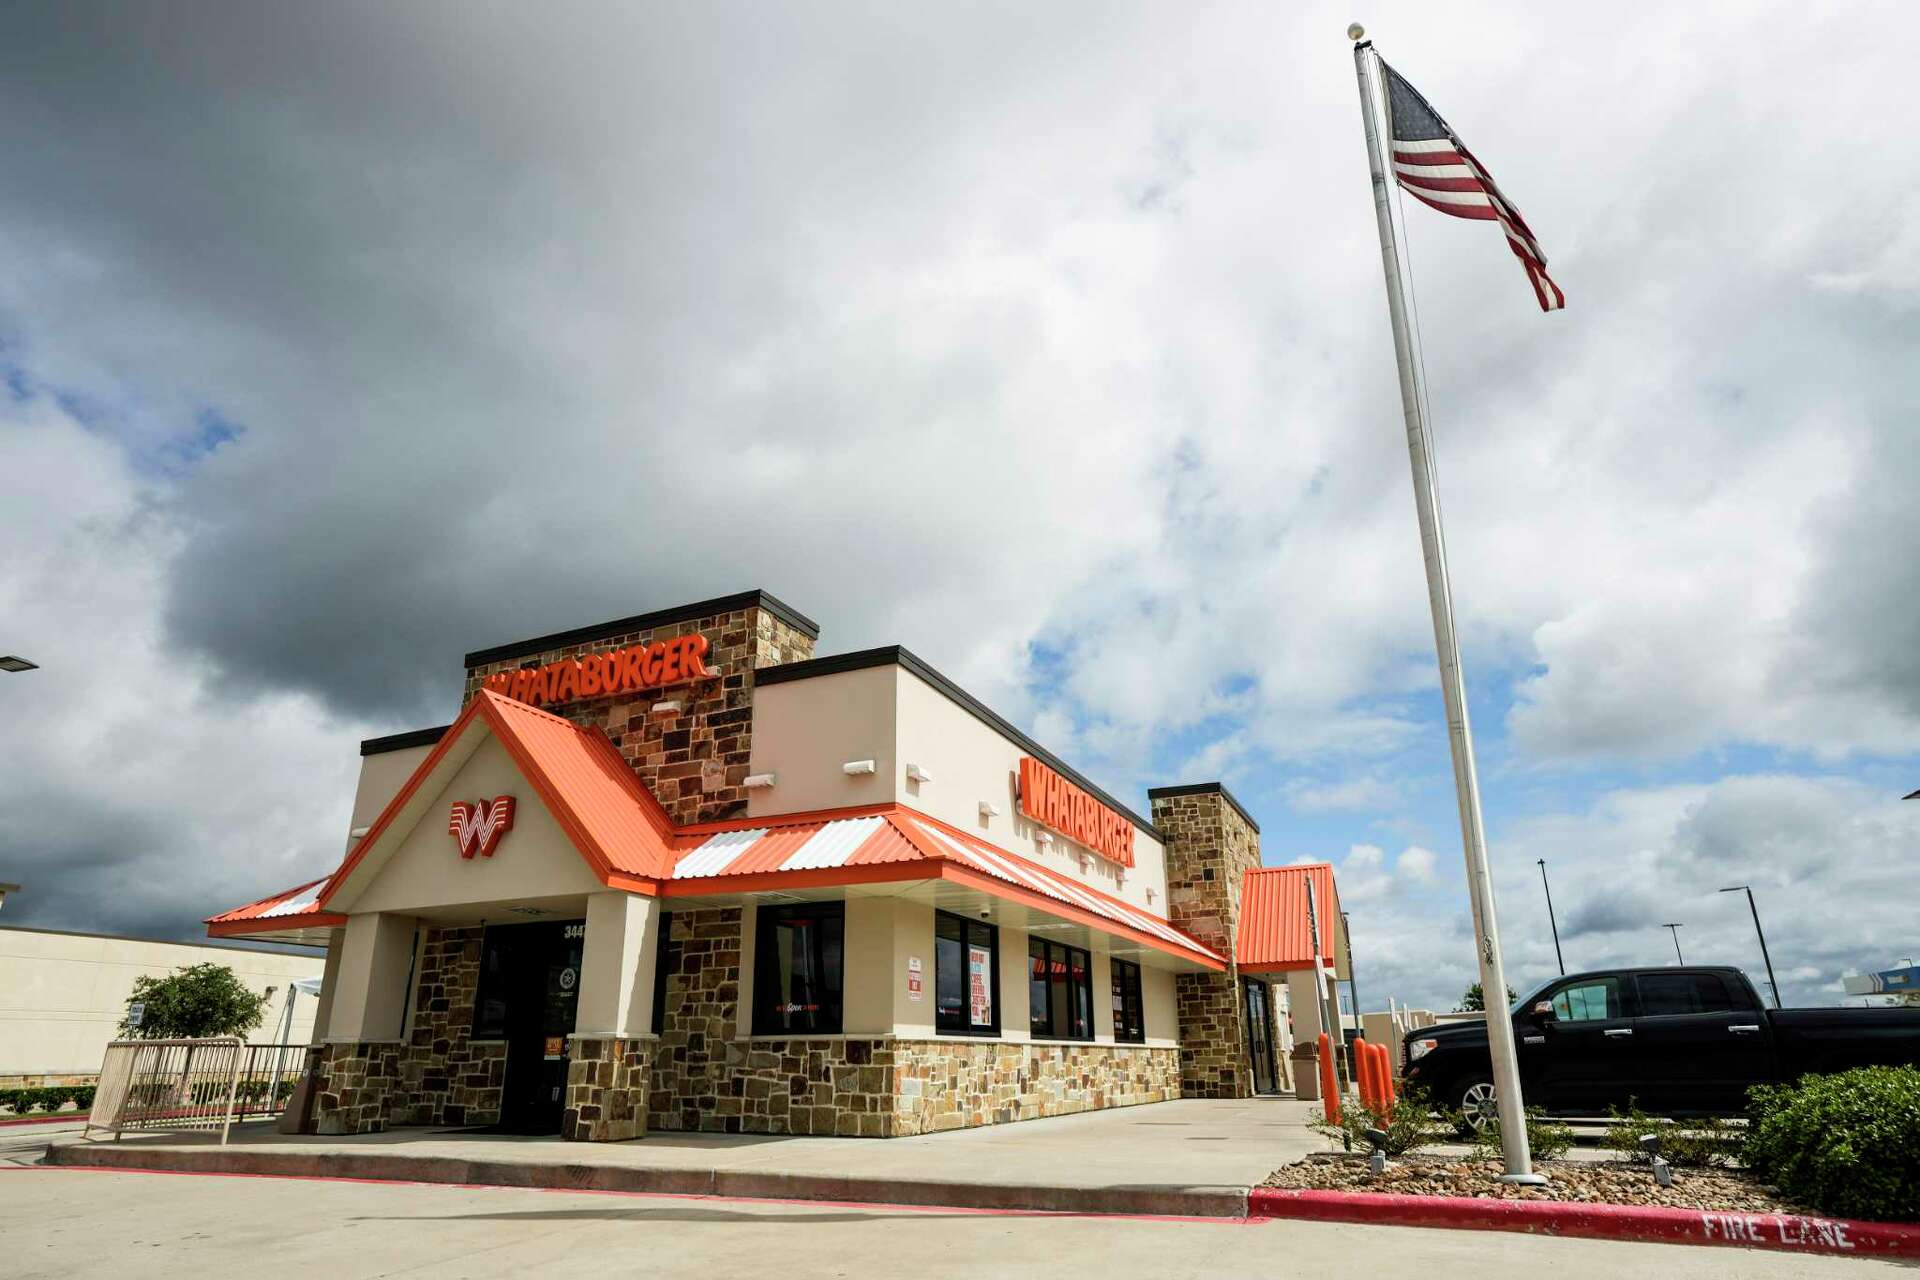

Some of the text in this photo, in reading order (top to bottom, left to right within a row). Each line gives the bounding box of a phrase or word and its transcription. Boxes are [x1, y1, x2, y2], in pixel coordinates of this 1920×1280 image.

[1020, 757, 1135, 868] WHATABURGER
[564, 925, 586, 939] 344
[1702, 1214, 1856, 1249] FIRE LANE
